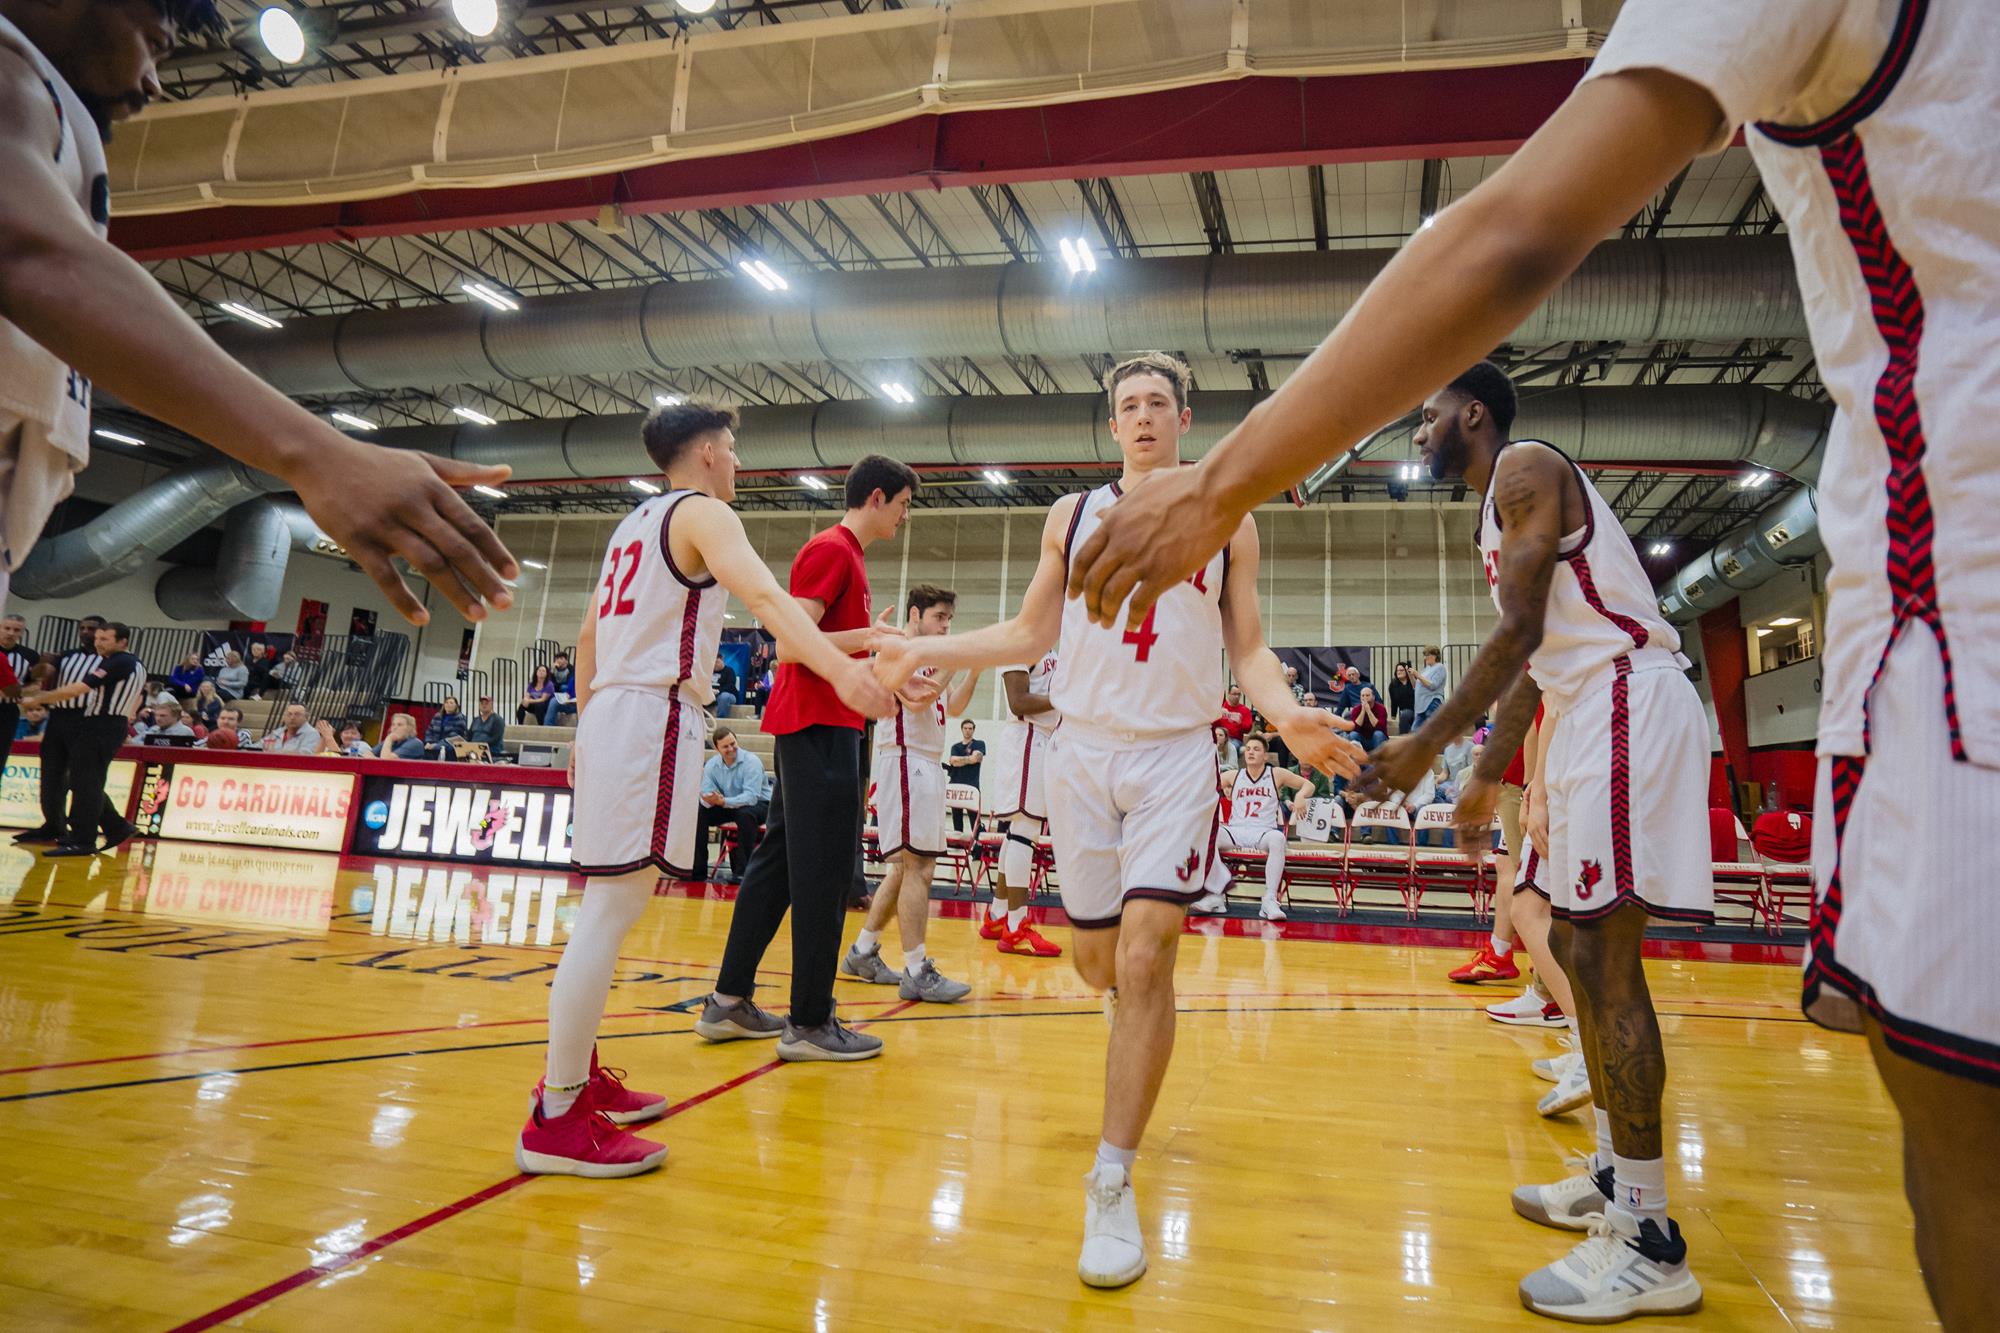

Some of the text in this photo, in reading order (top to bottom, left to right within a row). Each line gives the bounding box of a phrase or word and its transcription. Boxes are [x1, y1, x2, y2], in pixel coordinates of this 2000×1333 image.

[599, 539, 643, 620] 32
[1122, 600, 1160, 663] 4
[176, 775, 352, 819] GO CARDINALS
[945, 789, 974, 801] EWELL
[1236, 786, 1272, 800] JEWELL
[1245, 801, 1262, 818] 12
[1360, 807, 1401, 820] JEWELL
[1423, 810, 1453, 822] JEWE
[185, 819, 320, 841] www.jewellcardinals.com
[378, 784, 572, 864] JEWELL
